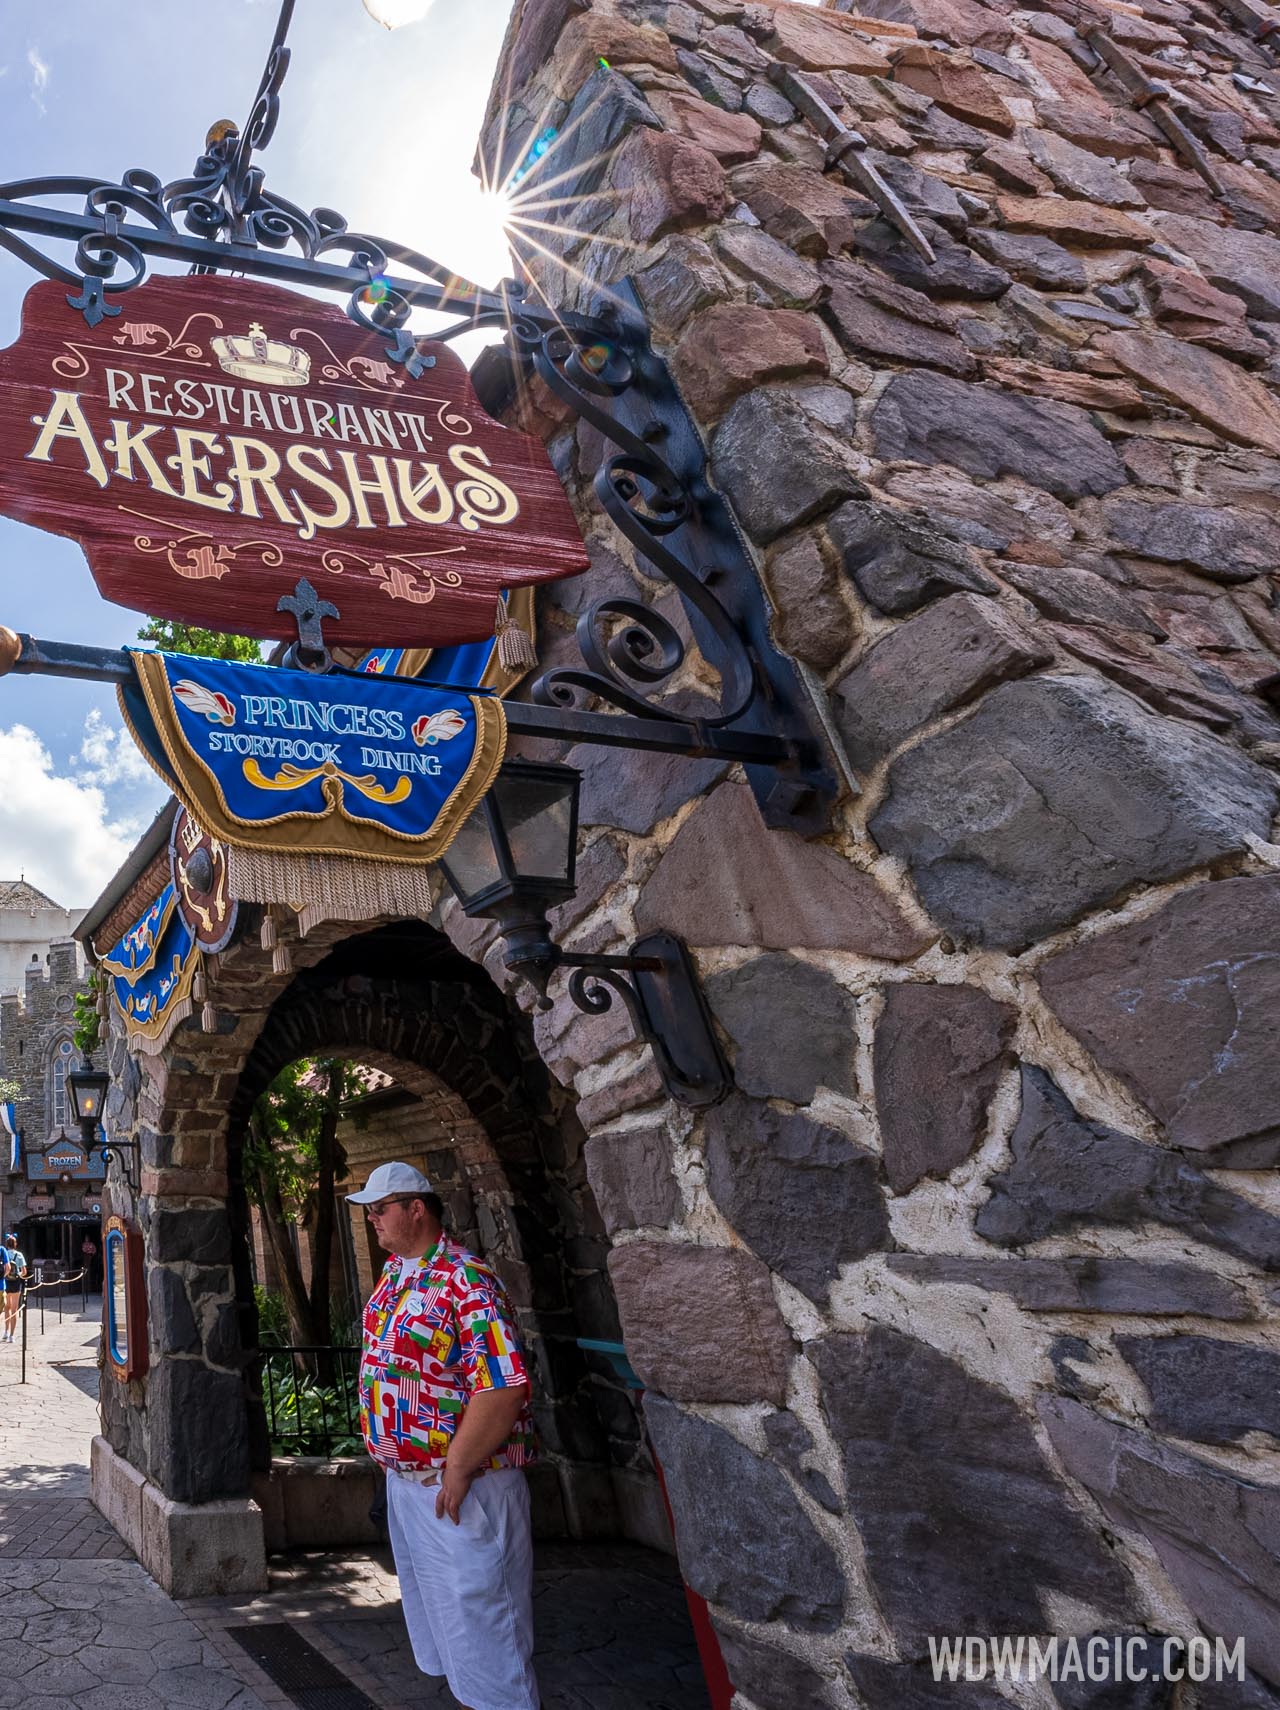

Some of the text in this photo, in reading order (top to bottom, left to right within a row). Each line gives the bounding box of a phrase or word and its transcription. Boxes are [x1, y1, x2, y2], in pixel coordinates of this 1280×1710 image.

[104, 367, 434, 454] RESTAURANT
[240, 694, 407, 741] PRINCESS
[208, 731, 443, 776] STORYBOOK DINING
[48, 1155, 82, 1167] FROZEN
